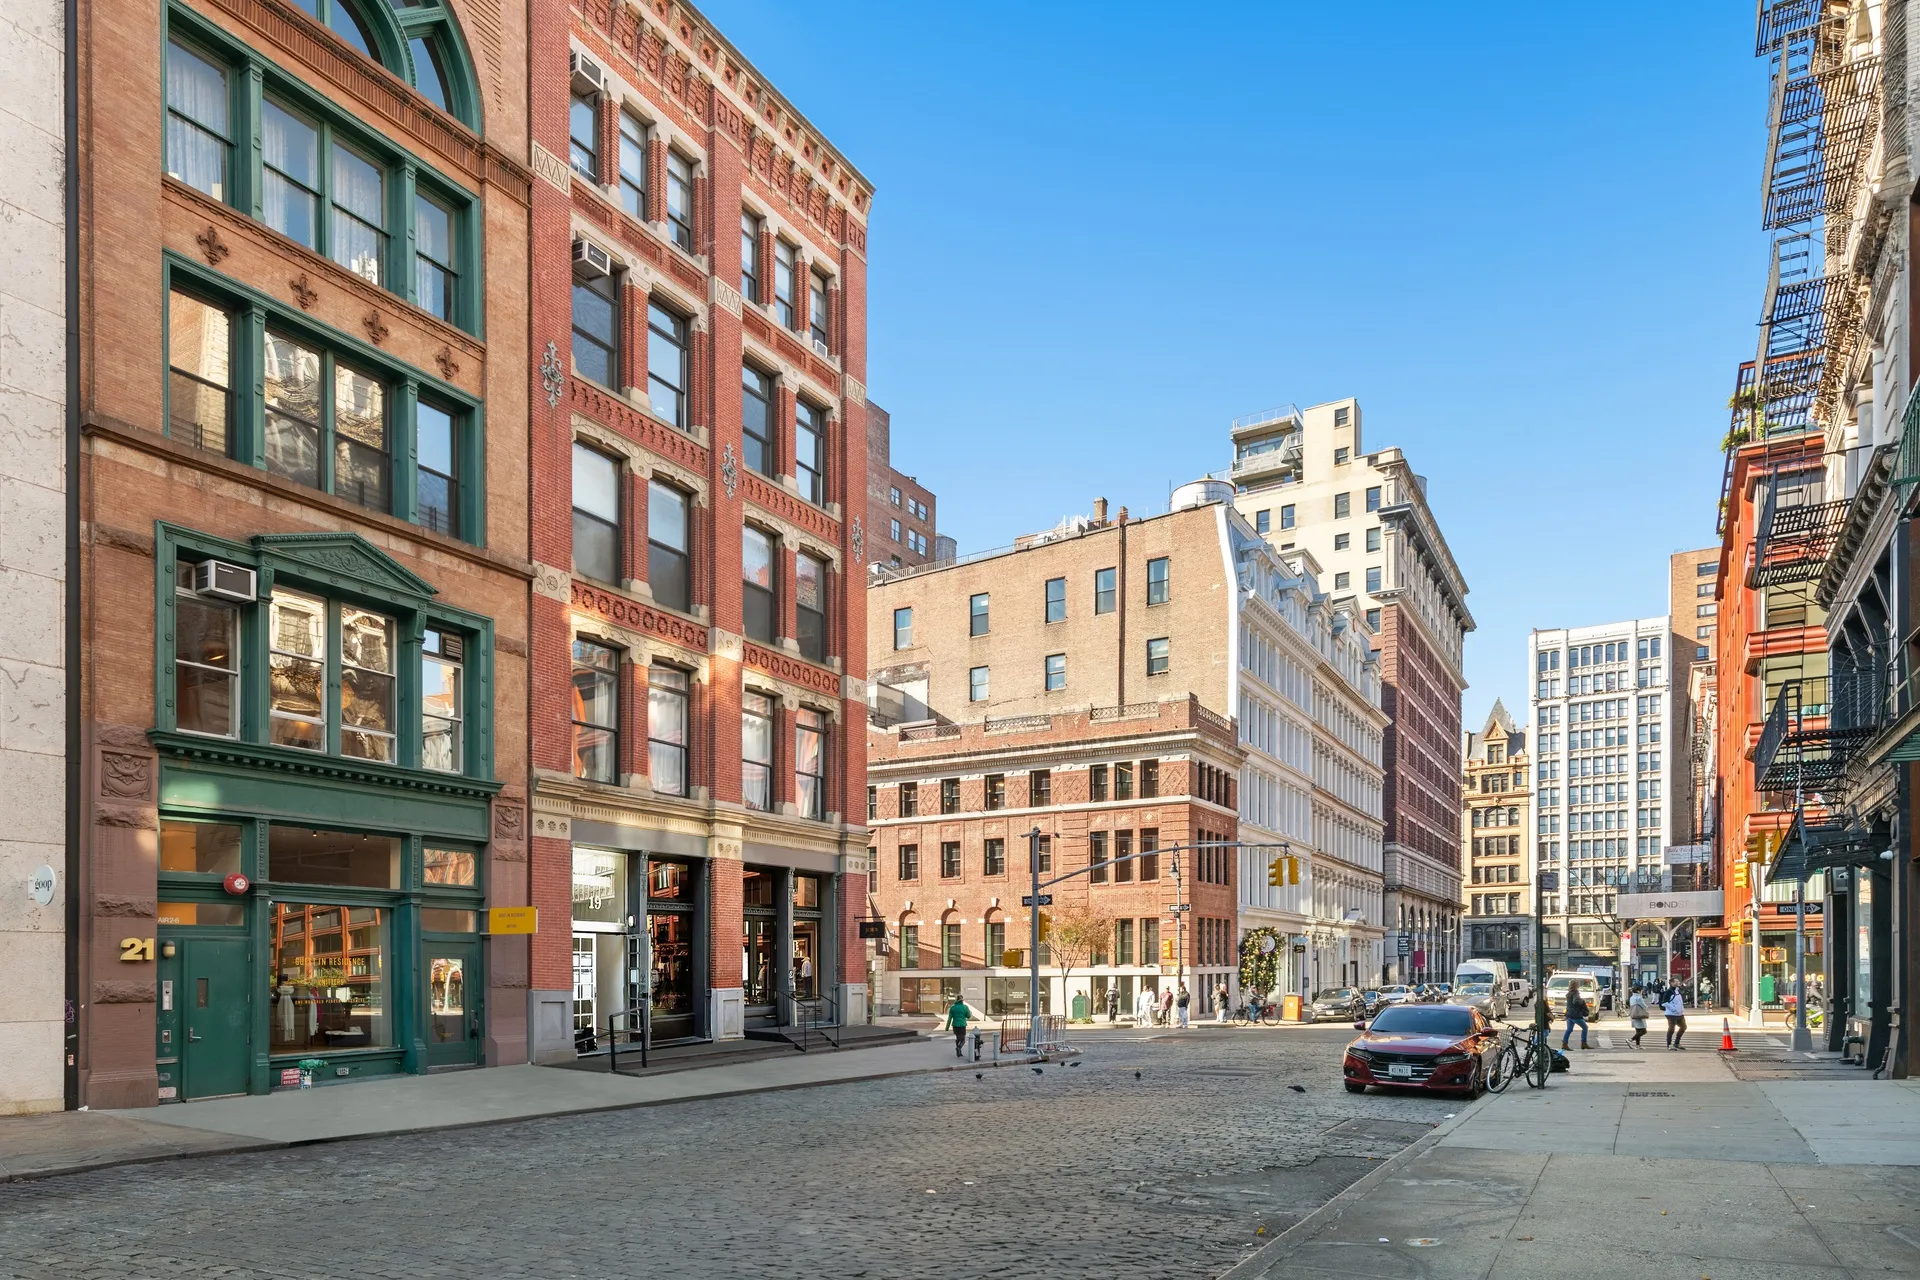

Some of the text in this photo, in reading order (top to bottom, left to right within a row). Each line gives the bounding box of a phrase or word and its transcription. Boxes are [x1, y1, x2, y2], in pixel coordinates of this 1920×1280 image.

[34, 879, 52, 891] goop
[588, 896, 602, 909] 19
[120, 938, 155, 961] 21
[295, 957, 365, 966] GUEST IN RESIDENCE
